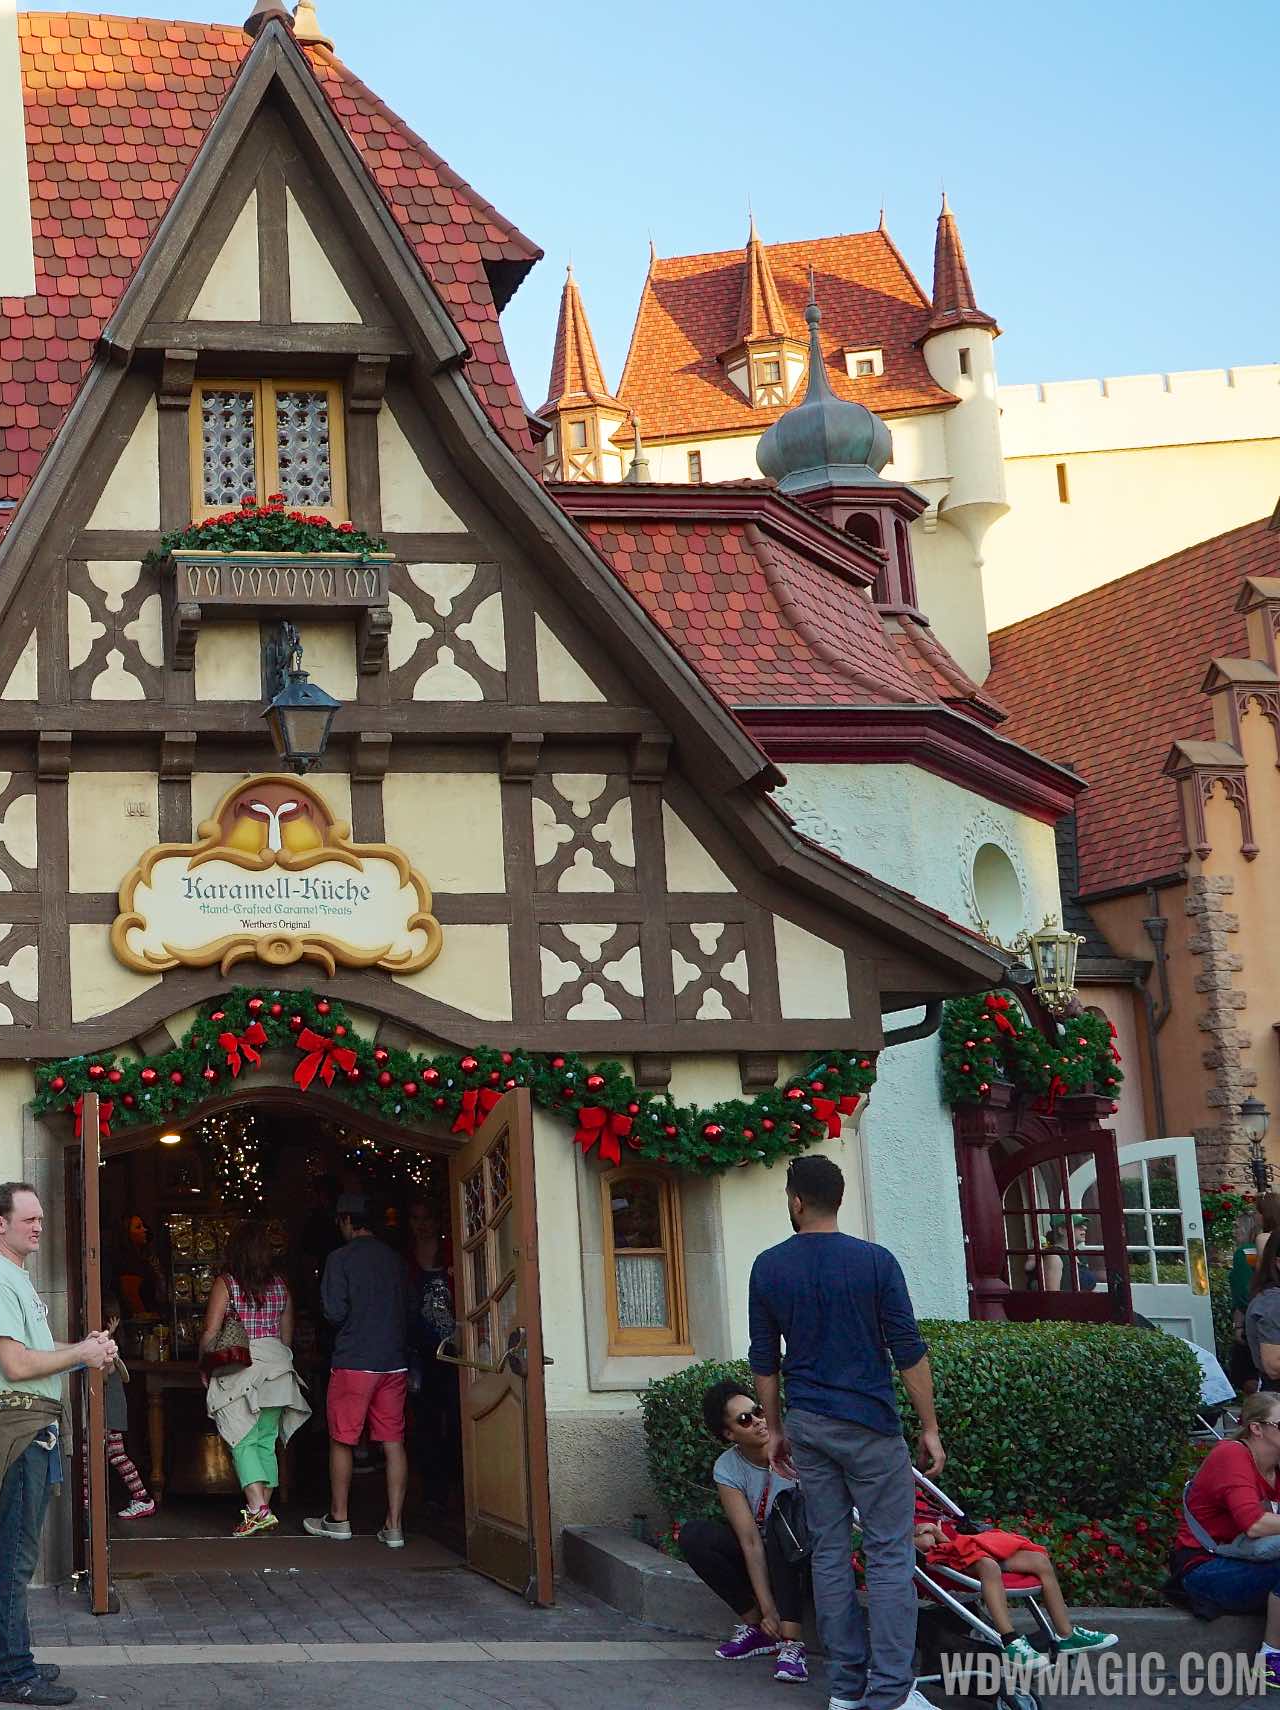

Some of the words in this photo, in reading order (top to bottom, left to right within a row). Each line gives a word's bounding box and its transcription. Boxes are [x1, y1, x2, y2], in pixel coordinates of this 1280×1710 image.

[181, 876, 370, 905] Karamell-Küche
[199, 903, 272, 917] Hand-Crafted
[273, 904, 318, 915] Caramel
[319, 904, 352, 915] Treats
[278, 919, 311, 930] Original
